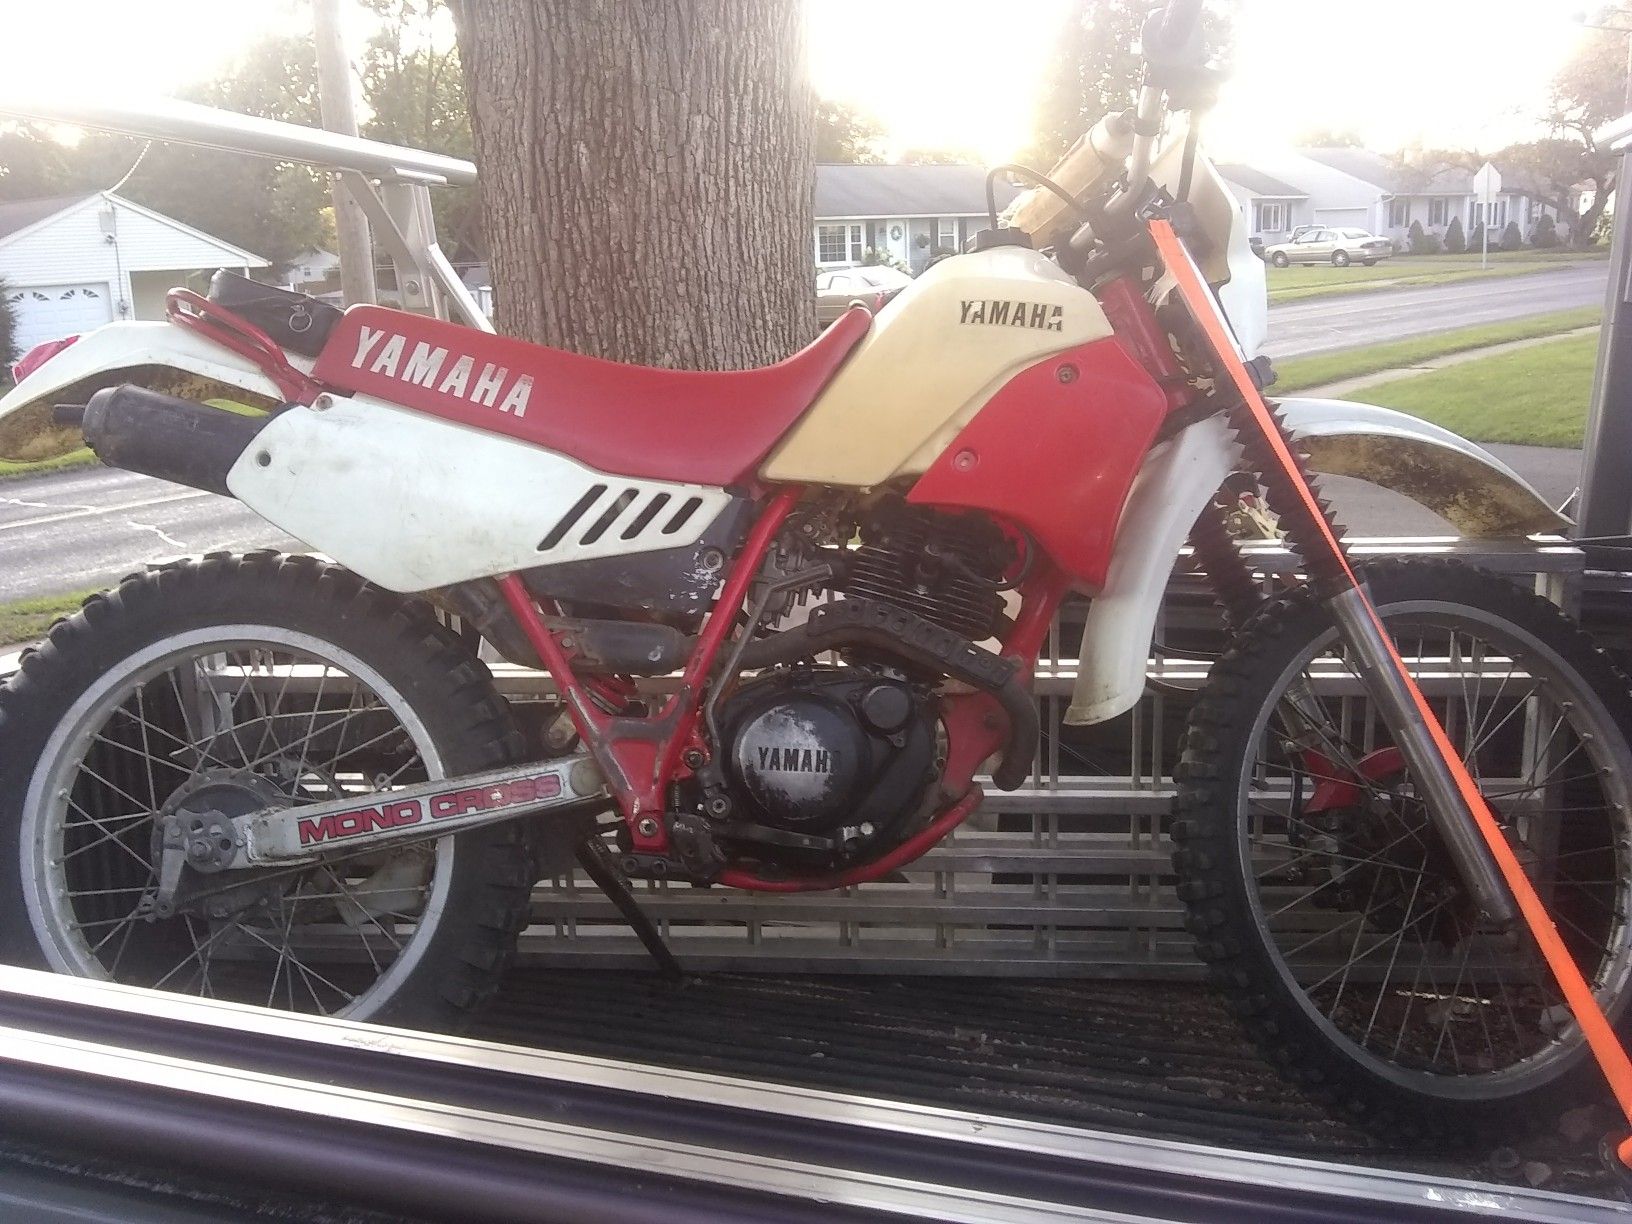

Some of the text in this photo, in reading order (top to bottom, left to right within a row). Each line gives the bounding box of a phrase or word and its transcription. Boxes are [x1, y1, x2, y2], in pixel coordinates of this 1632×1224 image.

[960, 300, 1063, 331] YAMAHA
[351, 325, 535, 418] YAMAHA
[298, 773, 562, 844] MONO CROSS
